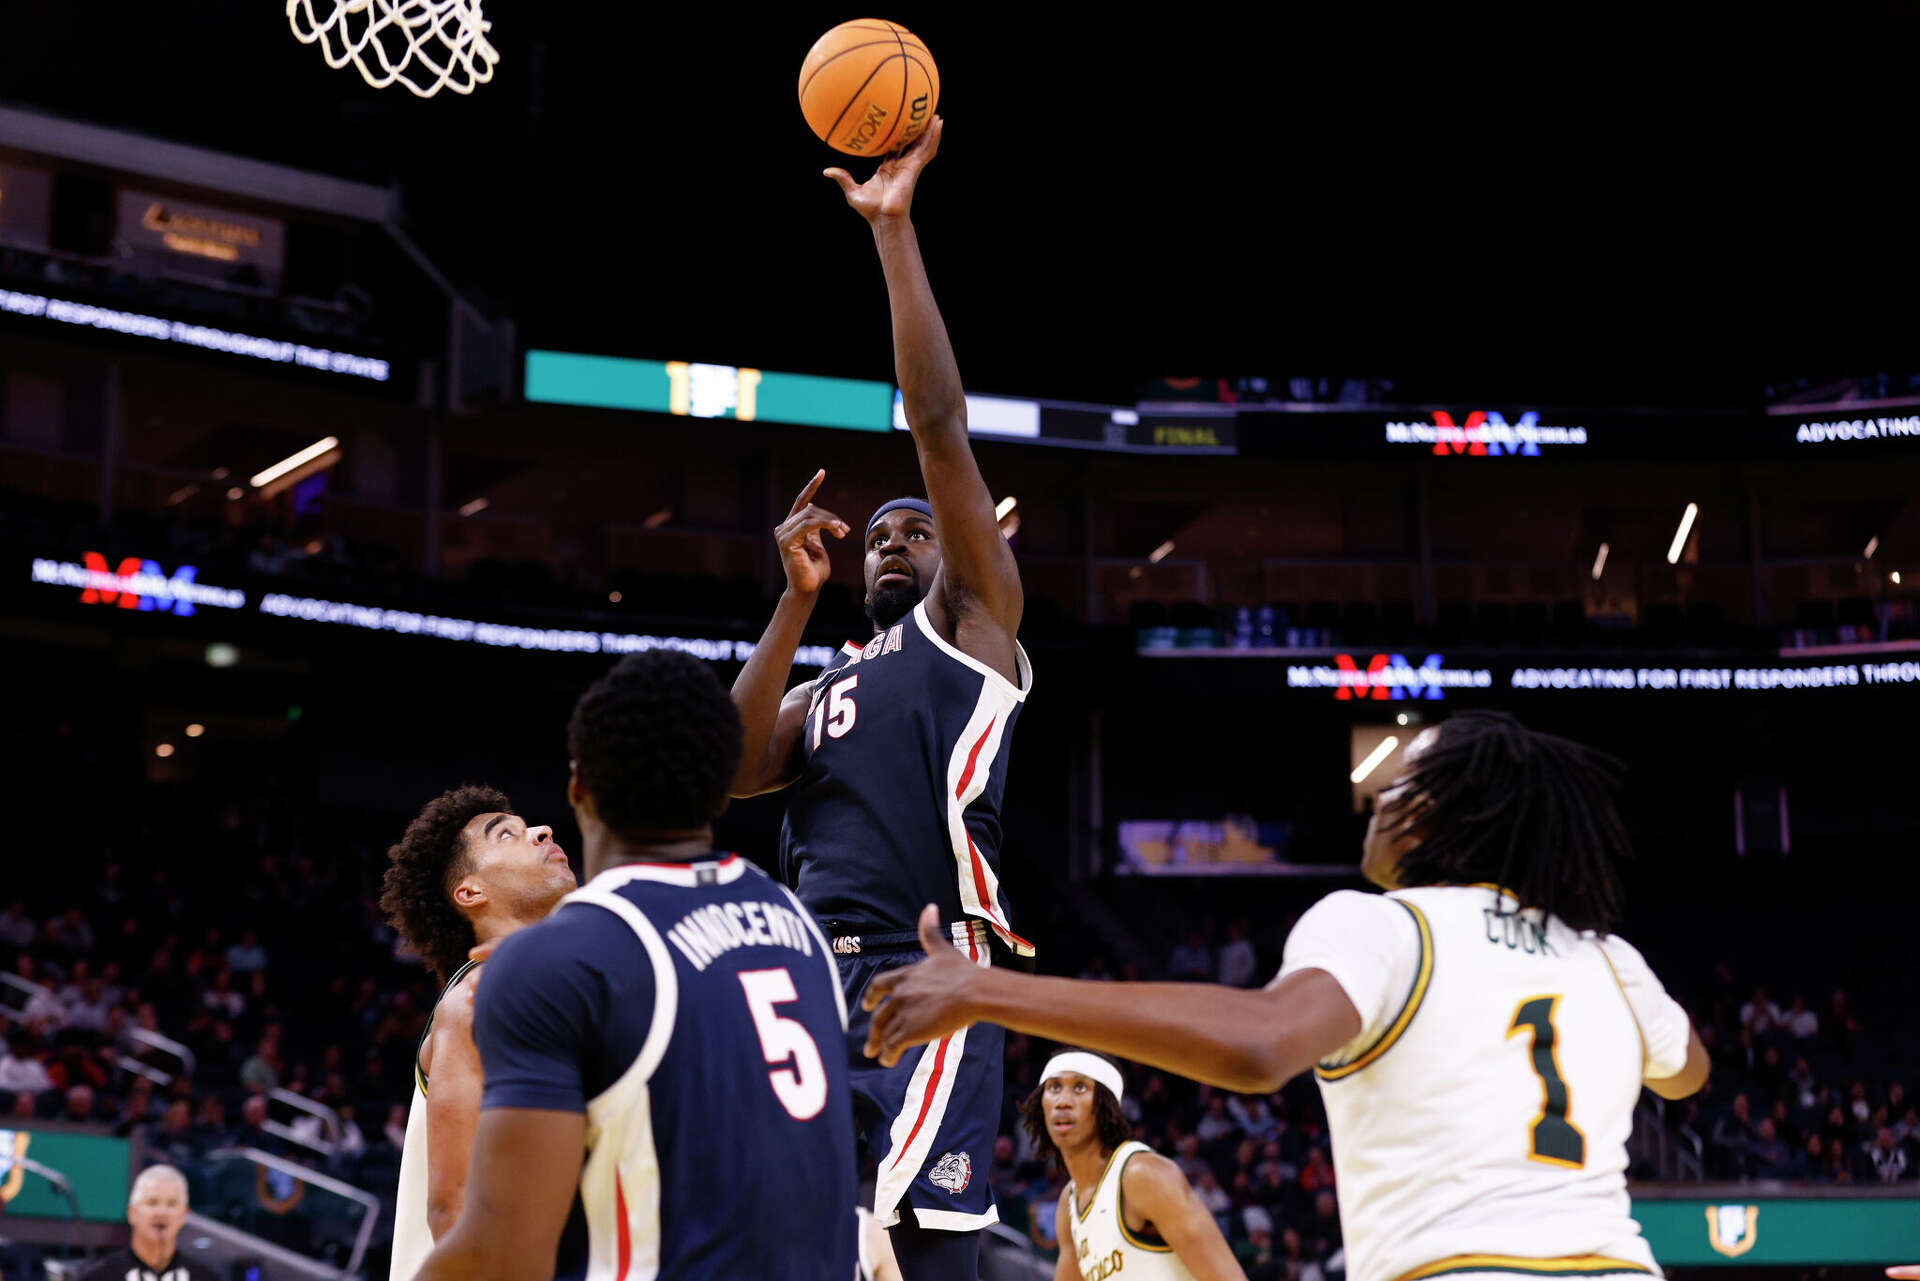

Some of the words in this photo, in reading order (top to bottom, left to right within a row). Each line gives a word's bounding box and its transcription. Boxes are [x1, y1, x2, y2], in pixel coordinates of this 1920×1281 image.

[1153, 426, 1220, 446] FINAL
[1796, 416, 1920, 443] ADVOCATING
[813, 673, 858, 752] 15
[1511, 668, 1636, 690] ADVOCATING
[1637, 668, 1679, 690] FOR
[1679, 668, 1732, 690] FIRST
[1734, 665, 1860, 690] RESPONDERS
[666, 901, 813, 972] INNOCENTI
[737, 967, 828, 1121] 5
[1505, 993, 1587, 1170] 1
